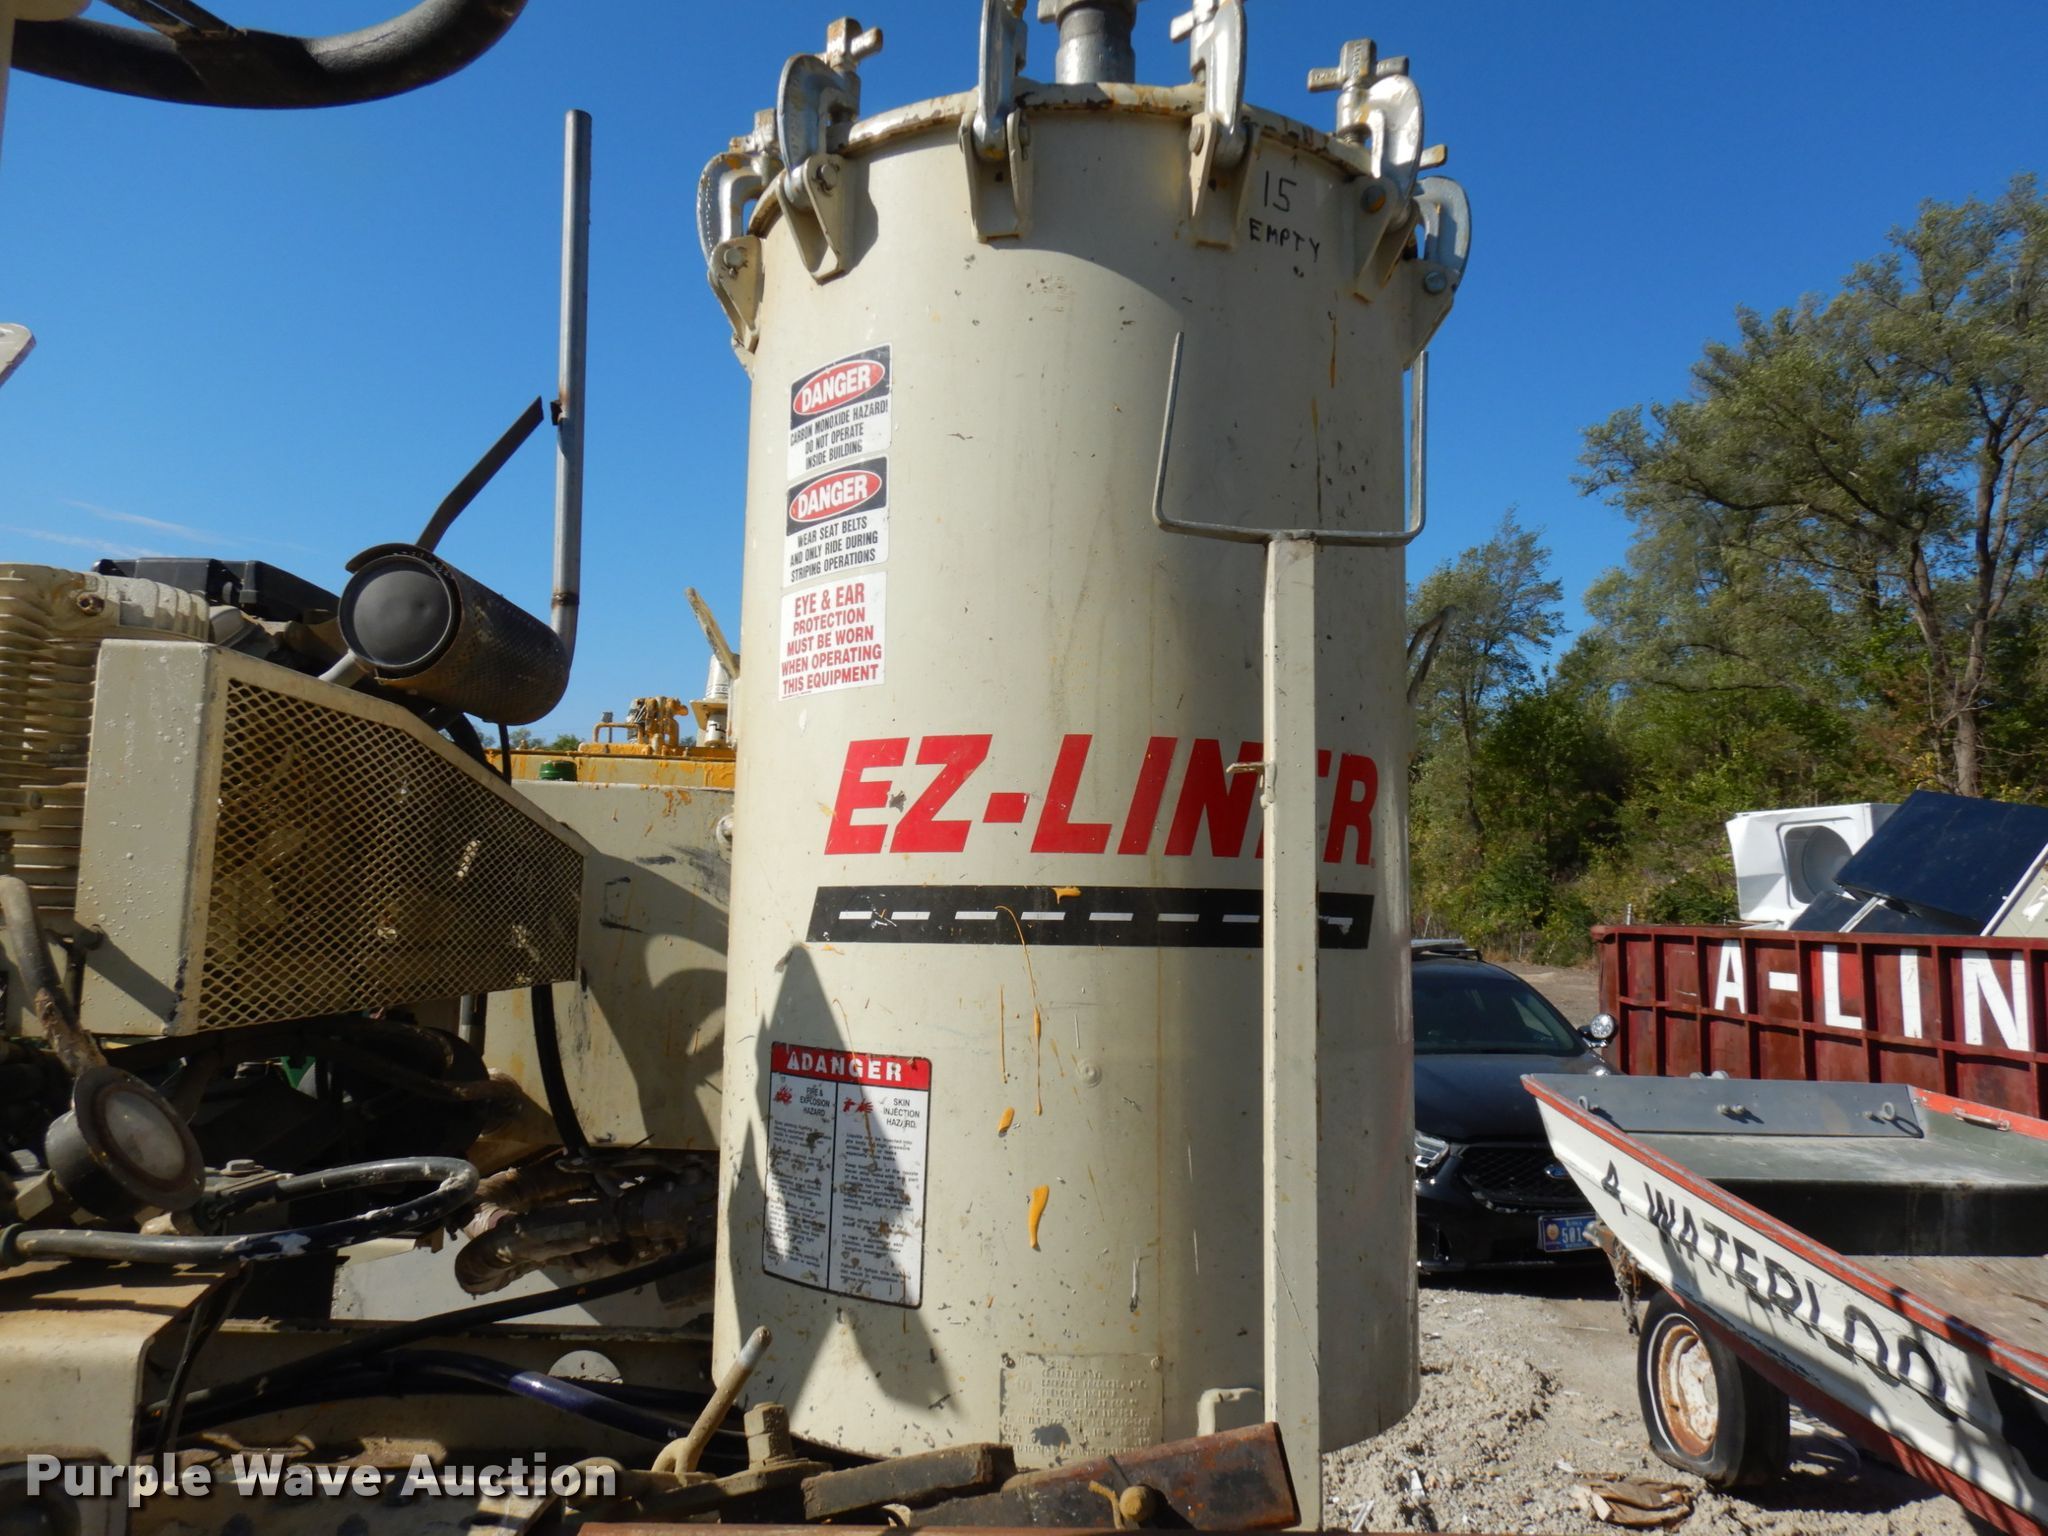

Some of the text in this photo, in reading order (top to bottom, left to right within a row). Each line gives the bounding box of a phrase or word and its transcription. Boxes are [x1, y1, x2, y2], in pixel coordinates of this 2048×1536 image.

[1264, 170, 1297, 212] 15
[1249, 217, 1320, 263] EMPTY
[801, 364, 872, 413] DANGER
[790, 399, 889, 447] CARBON MONOXIDE HAZARD!
[804, 422, 865, 455] DO NOT OPERATE
[805, 439, 864, 470] INSIDE BUILDING
[797, 474, 869, 519] DANGER
[789, 531, 879, 567] AND ONLY RIDE DURING
[797, 516, 868, 548] WEAR SEAT BELTS
[790, 549, 876, 583] STRIPING OPERATIONS
[794, 582, 866, 618] EYE & EAR
[793, 606, 866, 637] PROTECTION
[786, 625, 875, 657] MUST BE WORN
[781, 643, 883, 677] WHEN OPERATING
[782, 663, 880, 695] THIS EQUIPMENT
[824, 733, 1379, 866] EZ-LINR
[1713, 938, 2033, 1052] A-LIN
[801, 1051, 903, 1083] DANGER
[883, 1107, 920, 1119] INJECTION
[893, 1097, 911, 1107] SKIN
[1644, 1181, 1959, 1422] WATERLOO
